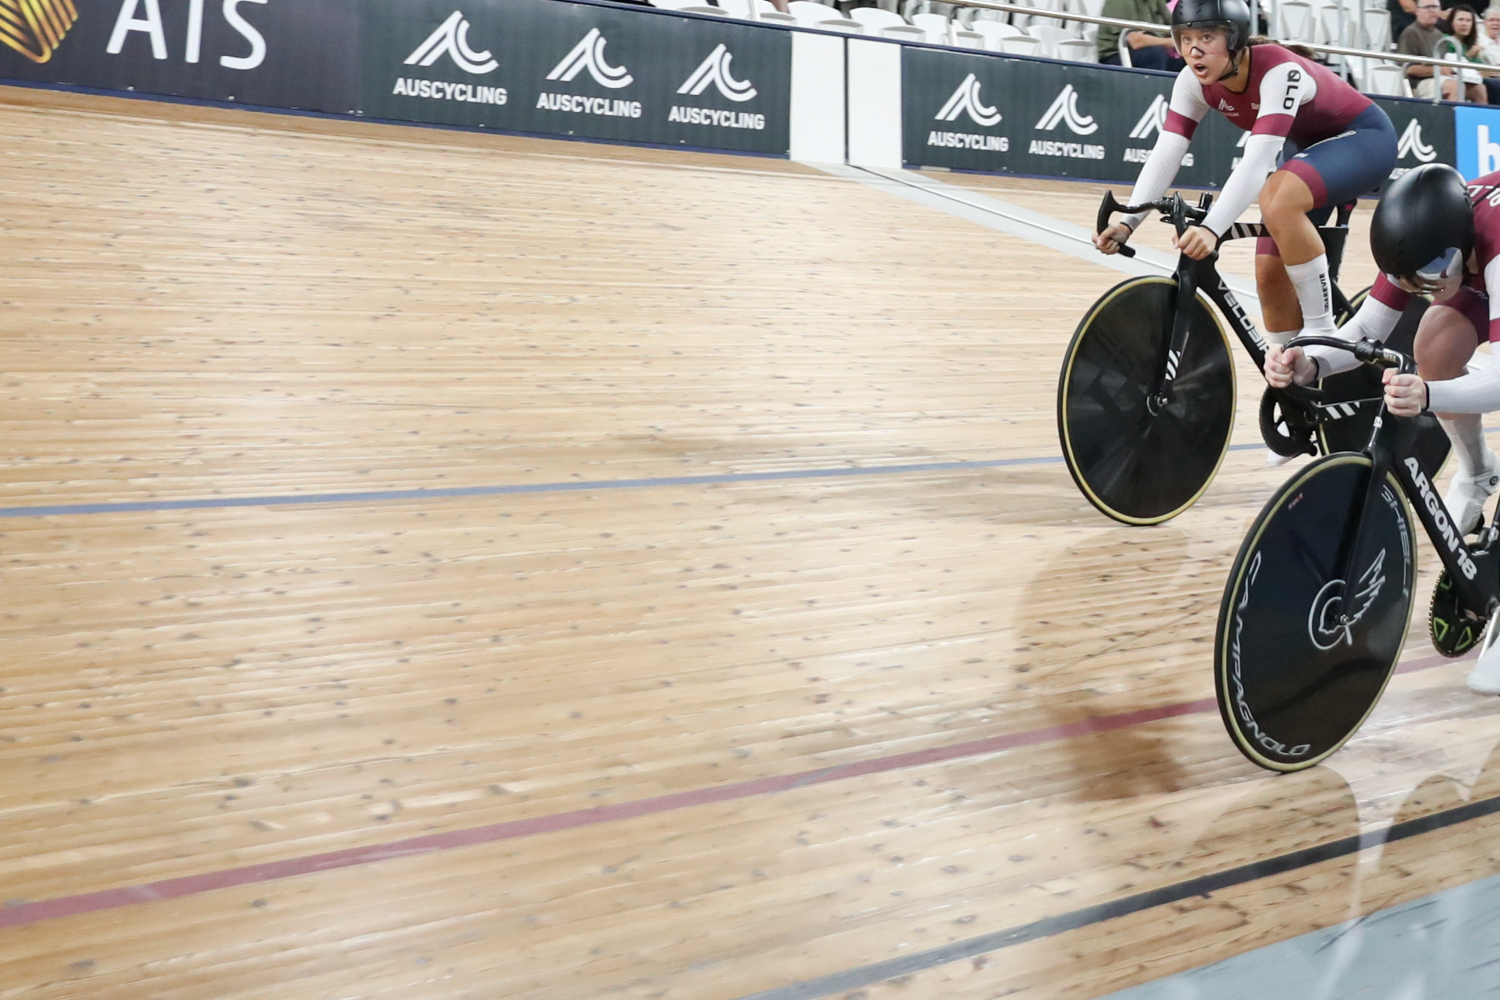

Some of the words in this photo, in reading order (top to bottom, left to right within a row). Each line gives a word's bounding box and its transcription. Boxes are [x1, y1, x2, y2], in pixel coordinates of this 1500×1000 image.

[392, 78, 508, 105] AUSCYCLING
[1282, 69, 1301, 110] QLD
[536, 93, 642, 119] AUSCYCLING
[668, 106, 765, 130] AUSCYCLING
[927, 131, 1009, 152] AUSCYCLING
[1028, 140, 1106, 160] AUSCYCLING
[1403, 456, 1460, 553] ARGON
[1456, 547, 1478, 580] 18
[1232, 550, 1311, 756] CAMPAGNOLO
